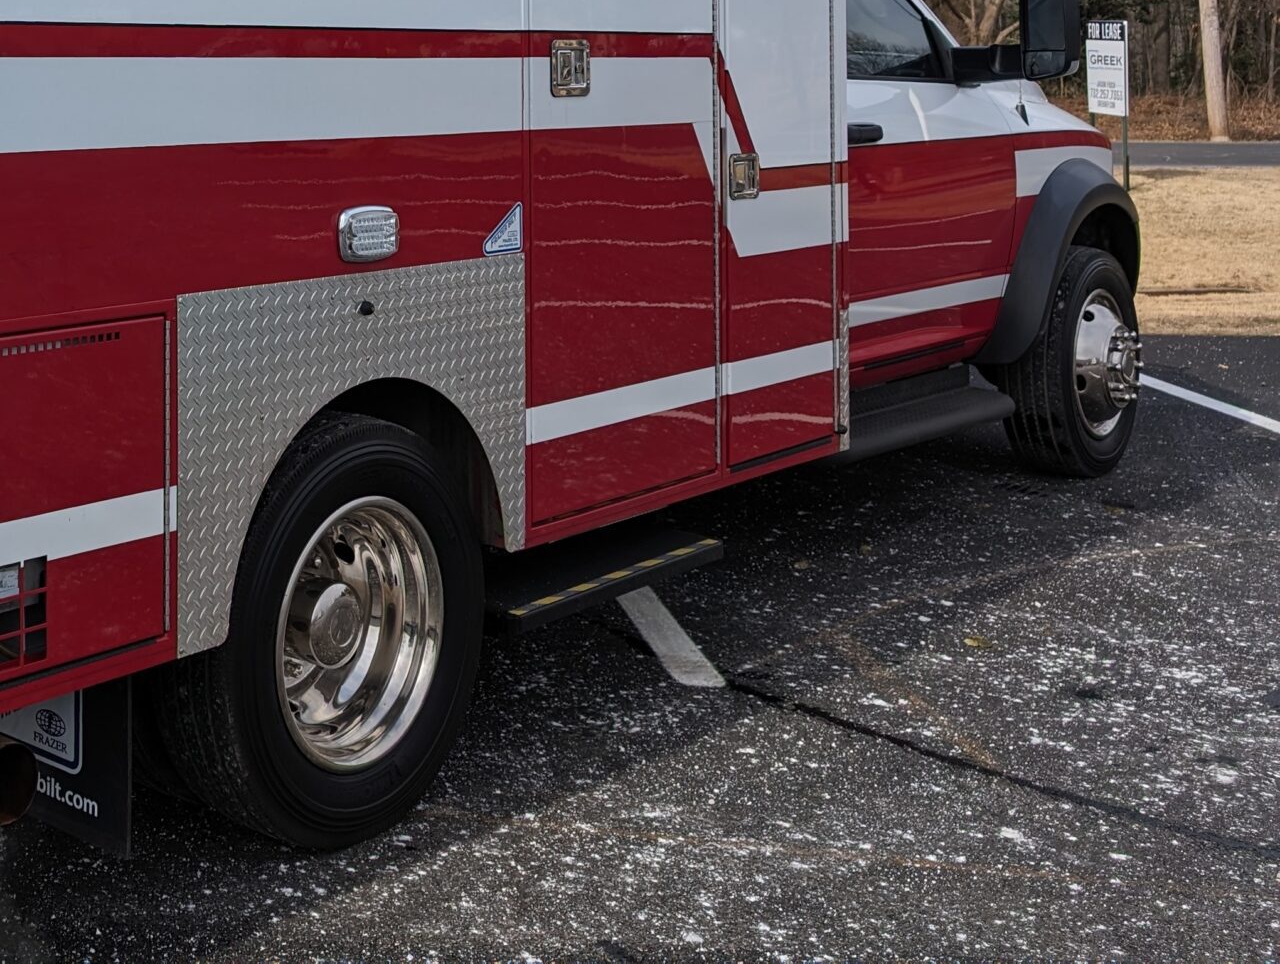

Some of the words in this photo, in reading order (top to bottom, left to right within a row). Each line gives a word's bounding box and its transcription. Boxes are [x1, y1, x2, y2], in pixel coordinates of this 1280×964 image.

[1087, 22, 1100, 39] FOR
[1101, 22, 1122, 40] LEASE
[1090, 54, 1123, 66] GREEK
[33, 730, 68, 755] FRAZER
